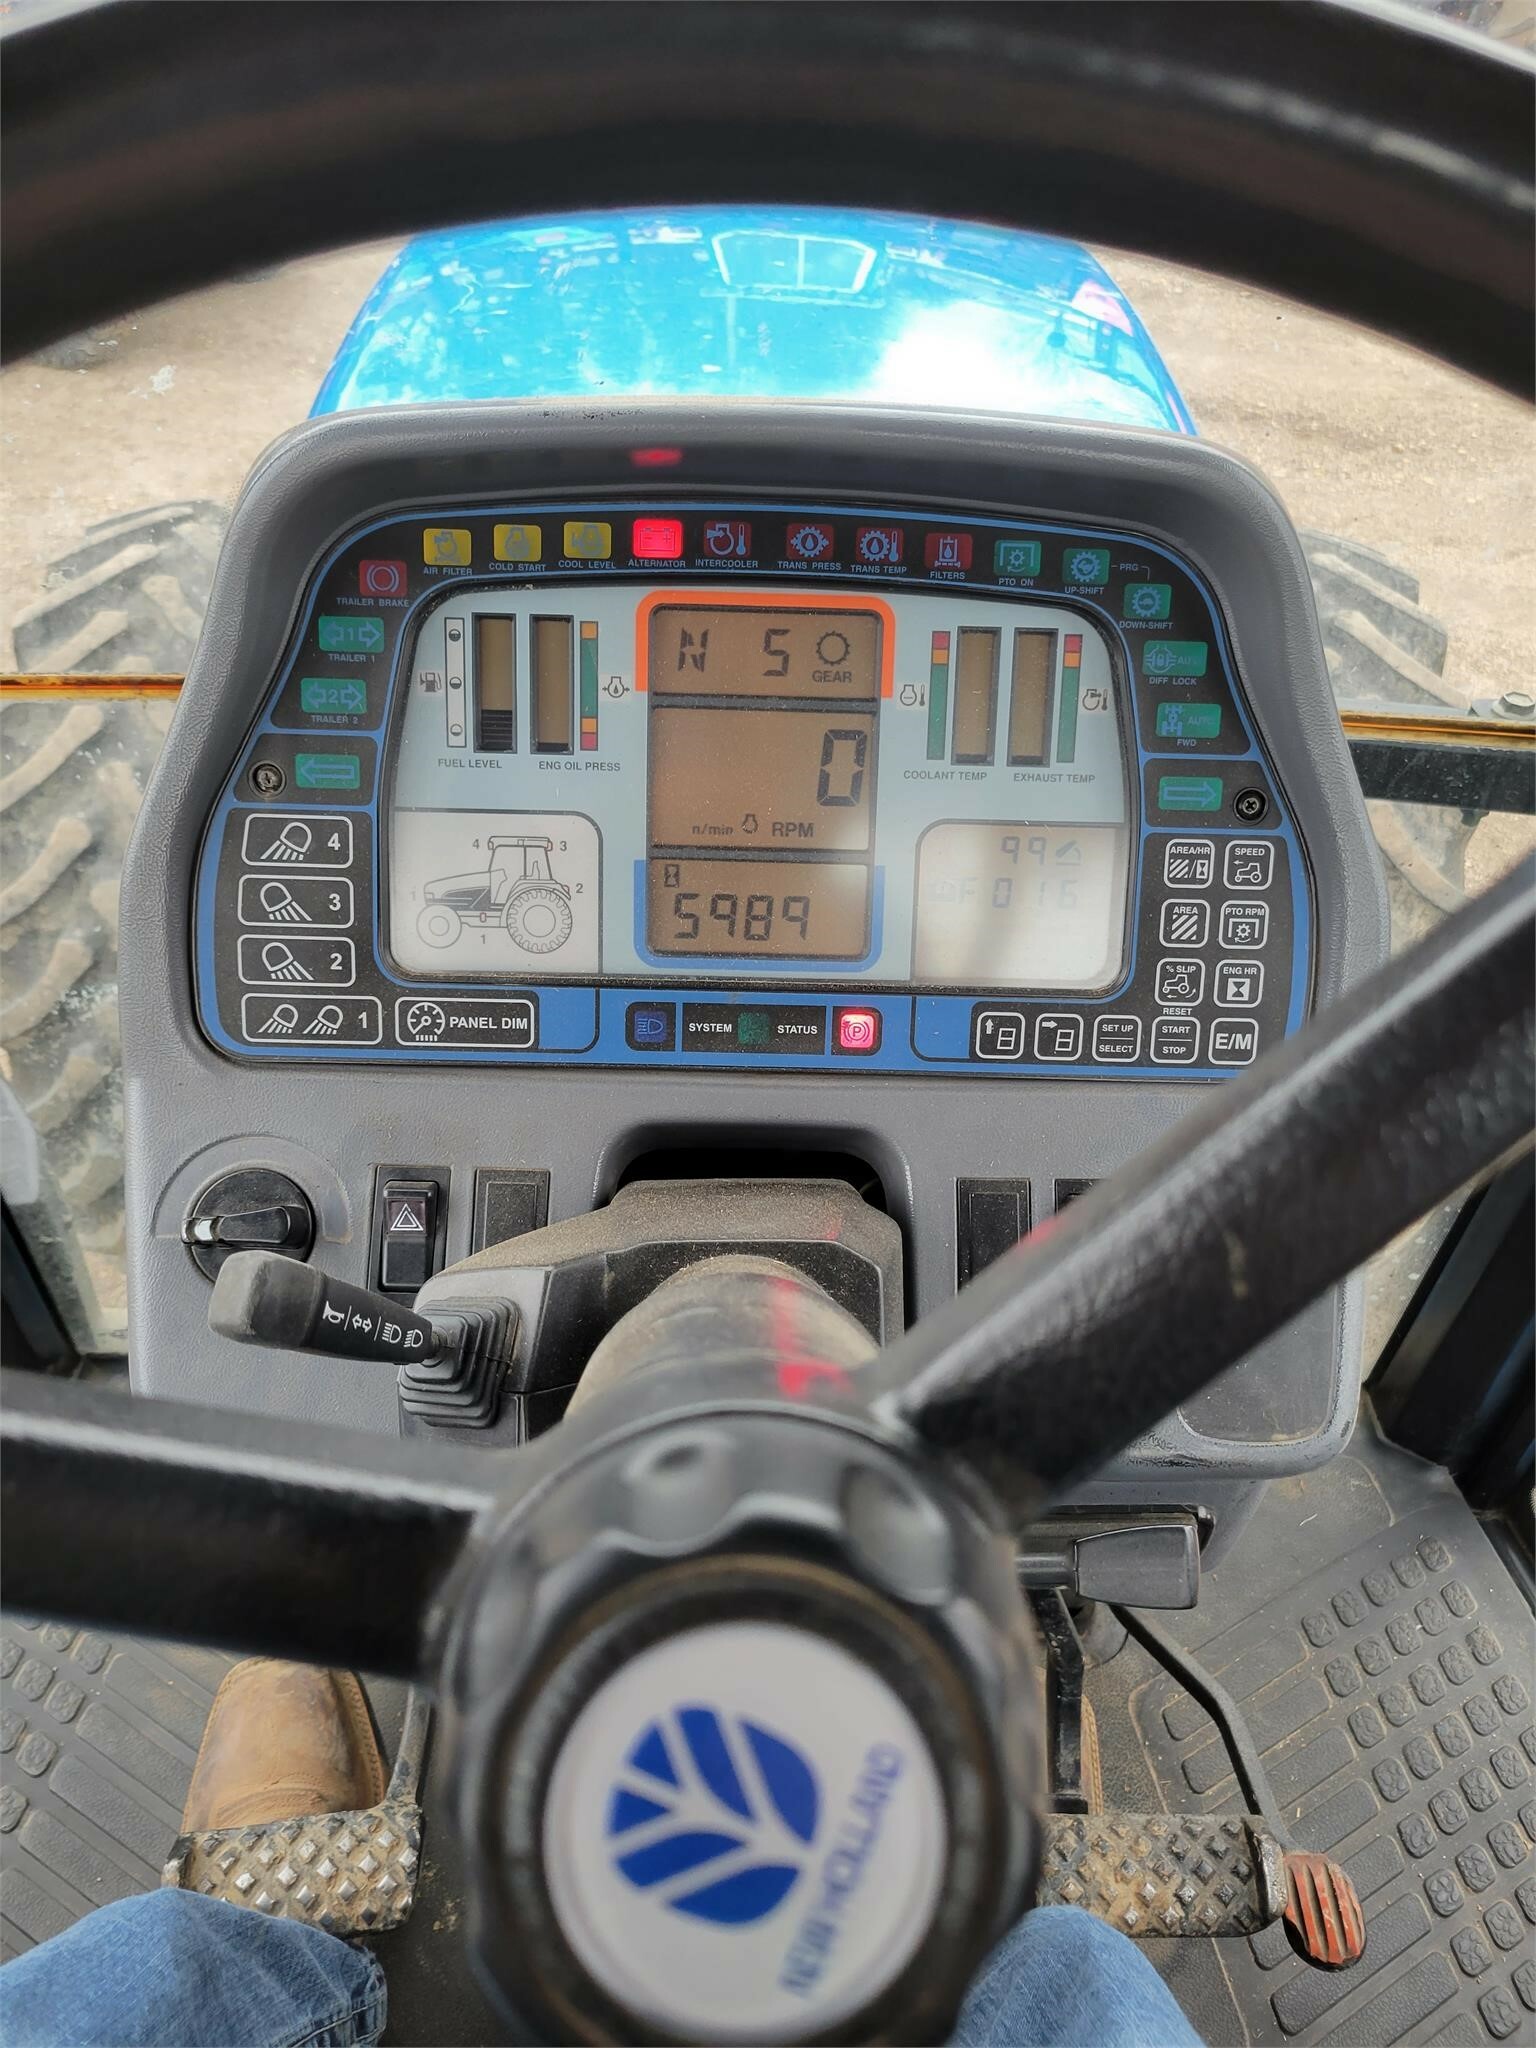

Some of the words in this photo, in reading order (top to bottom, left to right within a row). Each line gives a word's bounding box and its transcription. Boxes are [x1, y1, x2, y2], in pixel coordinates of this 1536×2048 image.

[489, 562, 514, 572] COLD
[518, 563, 546, 573] START
[558, 559, 584, 569] COOL
[588, 560, 616, 570] LEVEL
[628, 558, 686, 569] ALTERNATOR
[695, 558, 759, 569] INTERCOOLER
[777, 560, 809, 571] TRANS
[812, 561, 842, 571] PRESS
[1119, 563, 1139, 572] PRG
[423, 567, 440, 576] AIR
[443, 567, 473, 576] FILTER
[850, 564, 880, 574] TRANS
[883, 565, 907, 575] TEMP
[930, 571, 966, 580] FILTERS
[998, 577, 1016, 587] PTO
[1020, 578, 1034, 587] ON
[1064, 586, 1104, 596] UP-SHIFT
[336, 597, 374, 607] TRAILER
[378, 598, 410, 608] BRAKE
[1119, 620, 1173, 631] DOWN-SHIFT
[677, 627, 710, 673] N
[328, 653, 367, 663] TRAILER
[811, 671, 852, 684] GEAR
[1149, 676, 1168, 686] DIFF
[1173, 677, 1197, 686] LOCK
[328, 688, 339, 703] 2
[311, 714, 349, 724] TRAILER
[352, 716, 359, 725] 2
[1176, 738, 1197, 747] FWD
[438, 758, 465, 769] FUEL
[468, 759, 503, 769] LEVEL
[538, 761, 561, 771] ENG
[564, 761, 582, 771] OIL
[585, 762, 621, 772] PRESS
[816, 729, 868, 807] 0
[903, 770, 956, 781] COOLANT
[958, 772, 988, 781] TEMP
[1013, 773, 1064, 783] EXHAUST
[1067, 774, 1096, 784] TEMP
[692, 823, 734, 836] n/min
[771, 822, 815, 838] RPM
[327, 833, 341, 851] 4
[472, 839, 480, 849] 4
[559, 841, 567, 852] 3
[1169, 846, 1211, 855] AREA/HR
[1234, 847, 1265, 856] SPEED
[576, 883, 584, 894] 2
[328, 893, 342, 911] 3
[1172, 906, 1199, 915] AREA
[1225, 907, 1243, 916] PTO
[1245, 907, 1265, 916] RPM
[673, 892, 810, 941] 5989
[329, 952, 343, 970] 2
[1166, 965, 1174, 973] %
[1176, 965, 1196, 974] SLIP
[1223, 967, 1242, 975] ENG
[1244, 967, 1257, 975] HR
[1162, 1007, 1193, 1016] RESET
[357, 1012, 368, 1029] 1
[449, 1016, 498, 1030] PANEL
[501, 1017, 528, 1030] DIM
[688, 1022, 733, 1033] SYSTEM
[777, 1024, 818, 1035] STATUS
[1101, 1024, 1120, 1032] SET
[1121, 1024, 1134, 1033] UP
[1161, 1025, 1191, 1034] START
[1215, 1032, 1252, 1050] E/M
[1099, 1044, 1134, 1054] SELECT
[1162, 1046, 1186, 1055] STOP
